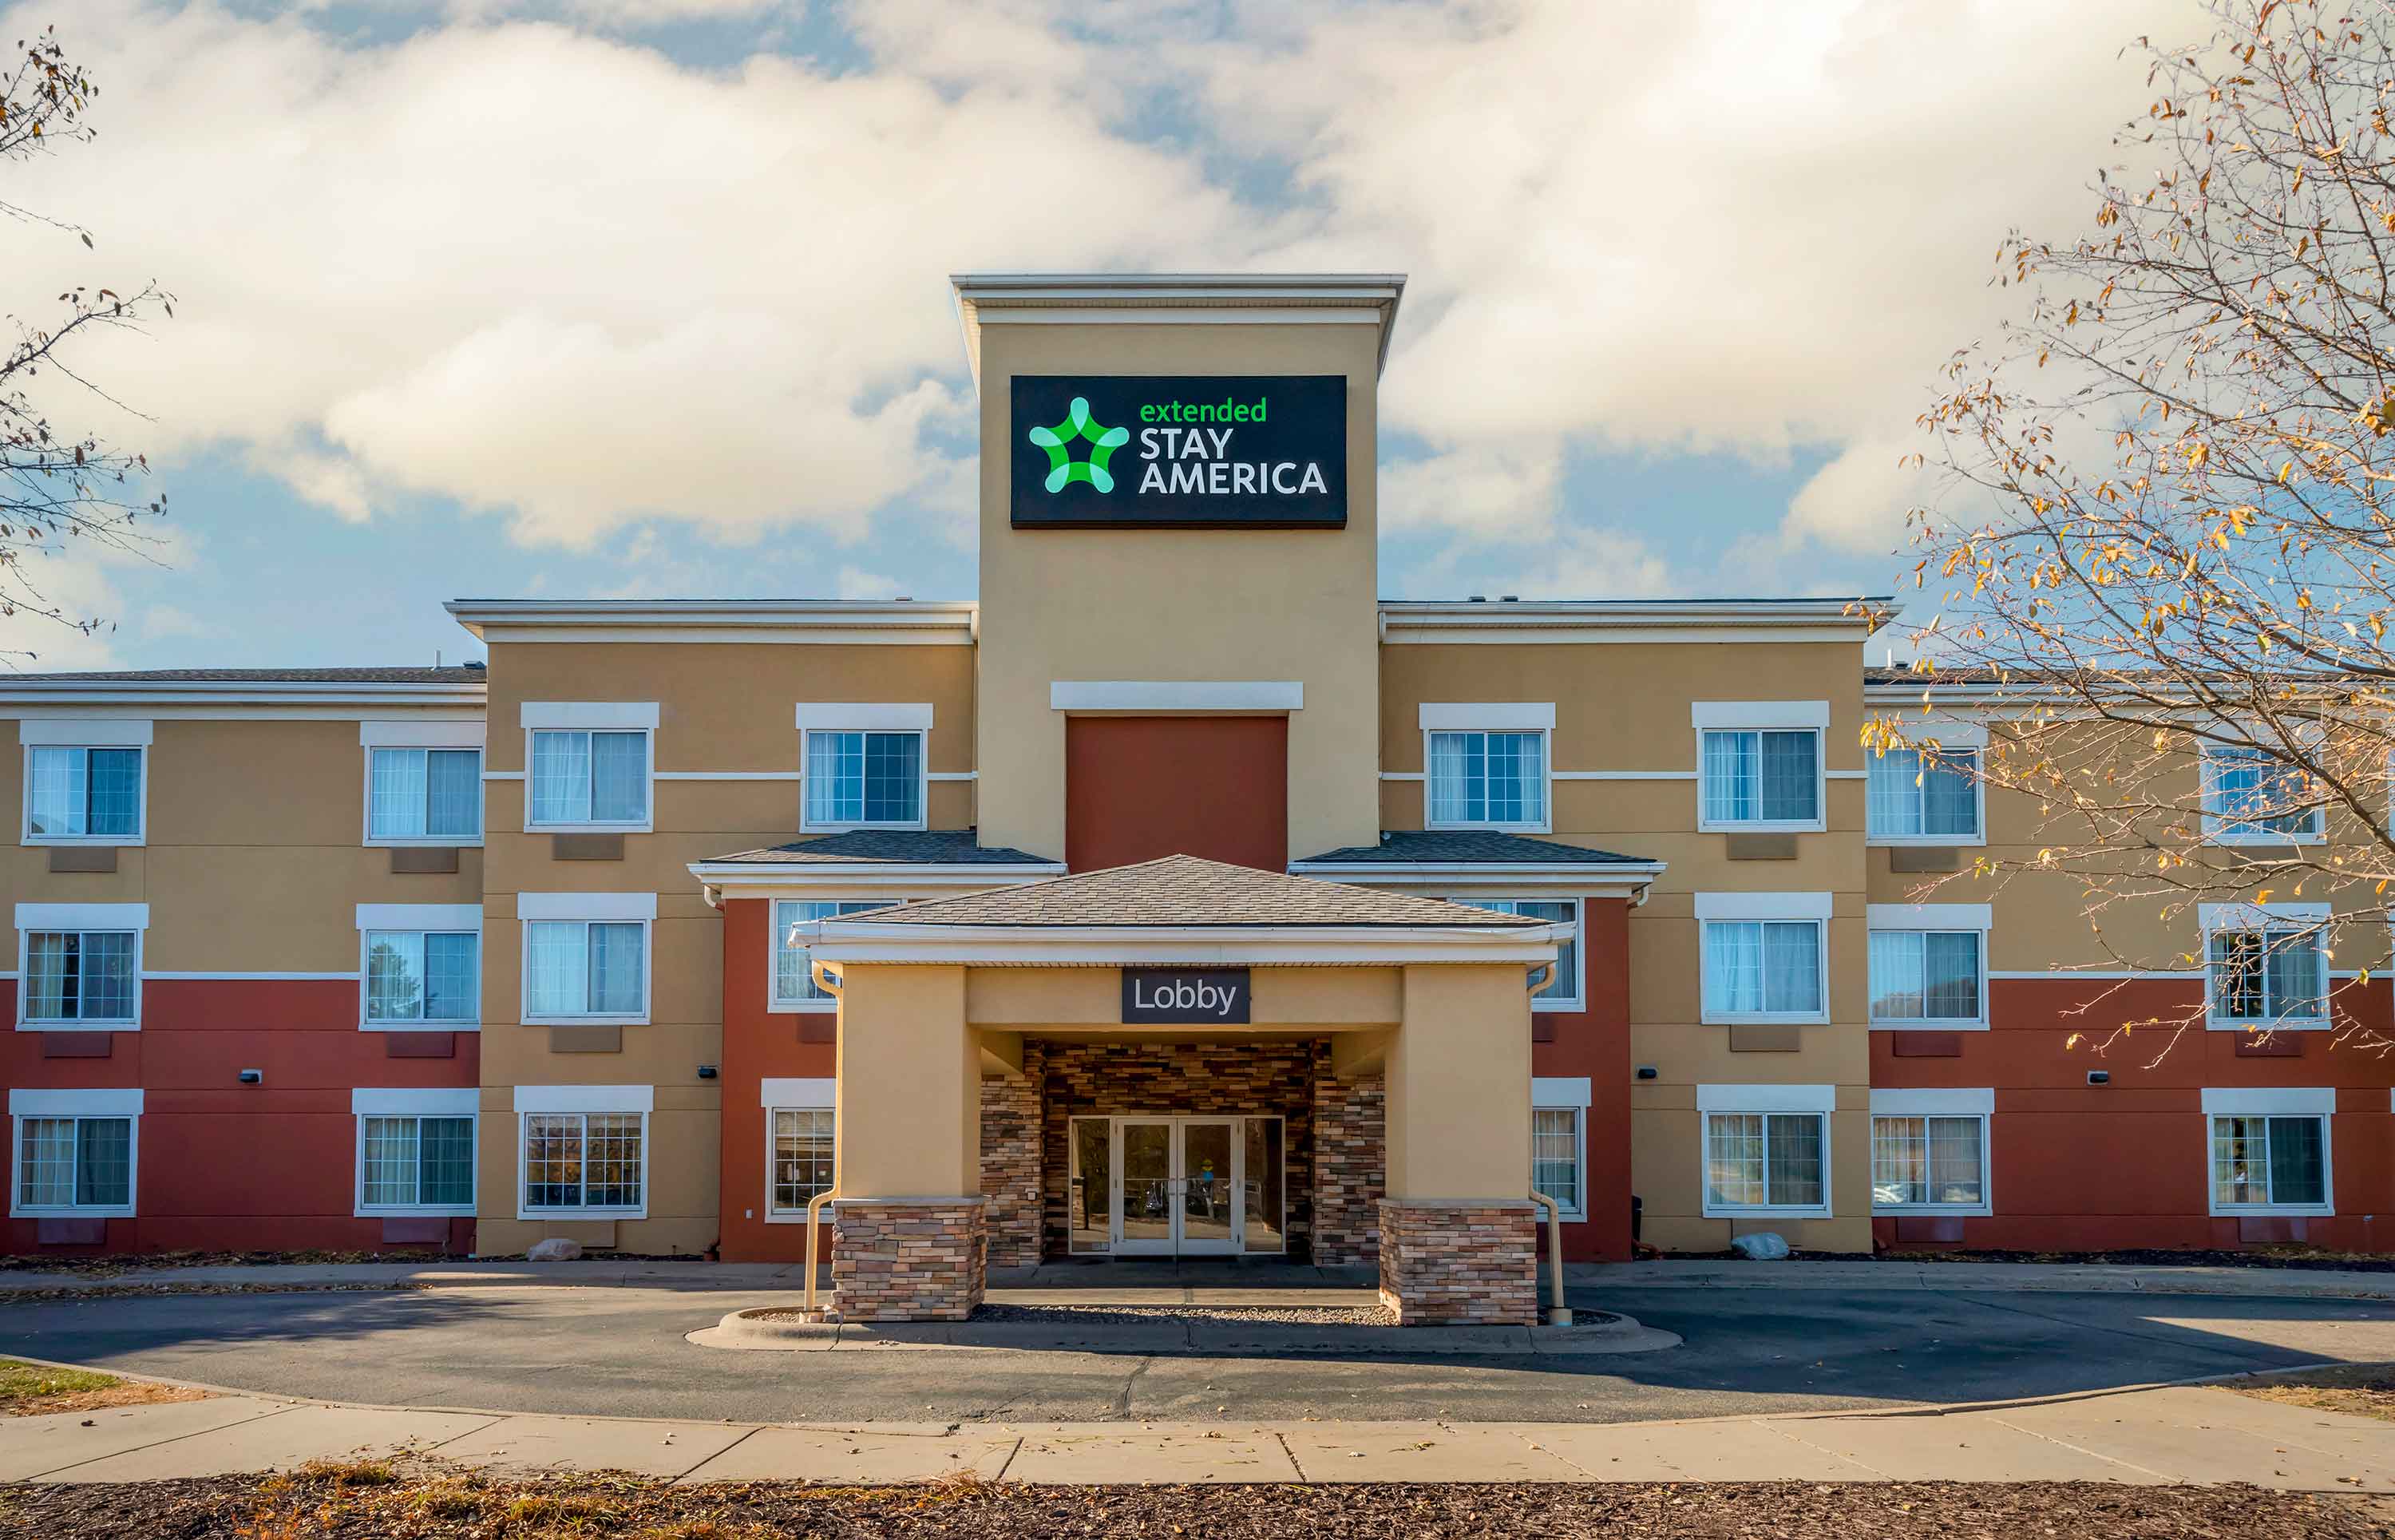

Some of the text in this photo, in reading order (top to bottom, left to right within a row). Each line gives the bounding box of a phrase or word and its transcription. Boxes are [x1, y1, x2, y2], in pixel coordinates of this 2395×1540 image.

[1140, 398, 1267, 422] extended
[1140, 428, 1234, 460] STAY
[1138, 462, 1328, 494] AMERICA
[1135, 979, 1237, 1015] Lobby
